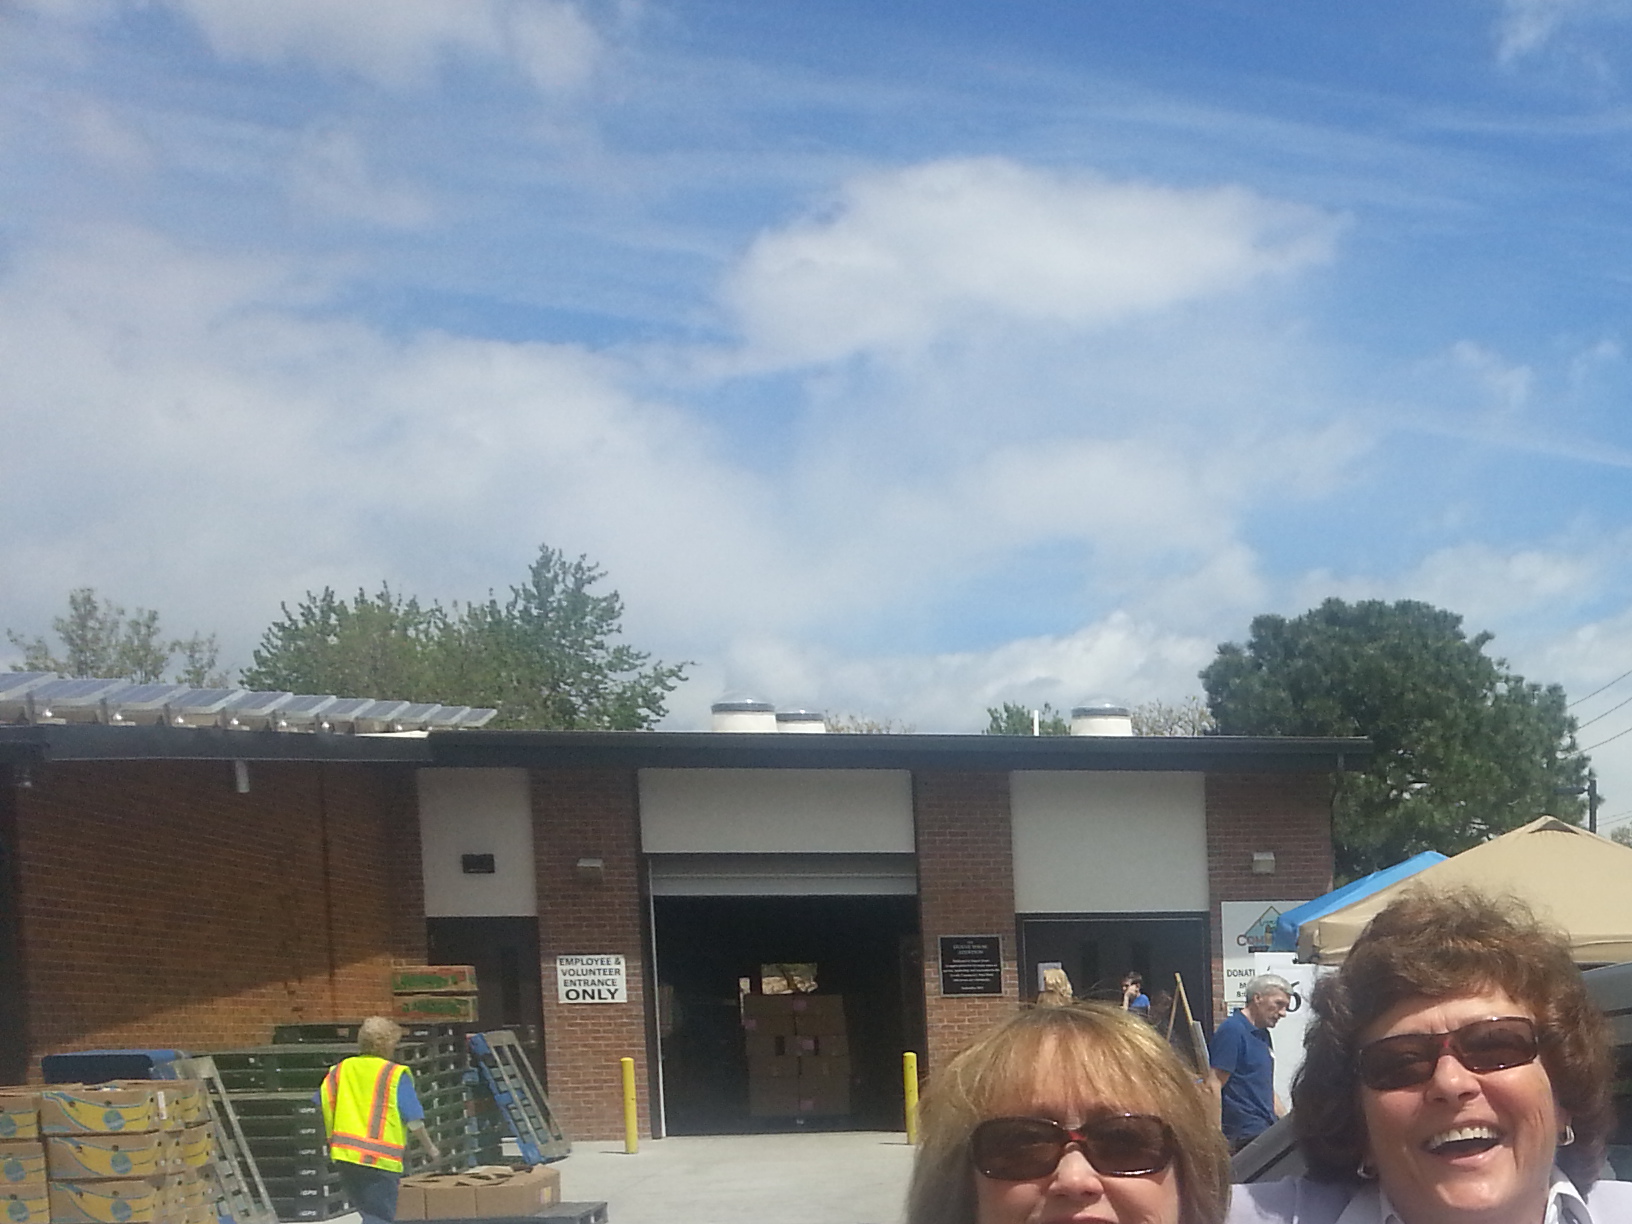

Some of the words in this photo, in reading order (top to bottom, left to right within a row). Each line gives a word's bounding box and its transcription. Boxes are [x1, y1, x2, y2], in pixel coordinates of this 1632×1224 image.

[559, 958, 612, 966] EMPLOYEE
[614, 957, 621, 965] &
[561, 968, 621, 976] VOLUNTEER
[1226, 969, 1256, 978] DONATI
[563, 979, 617, 987] ENTRANCE
[565, 988, 619, 1001] ONLY
